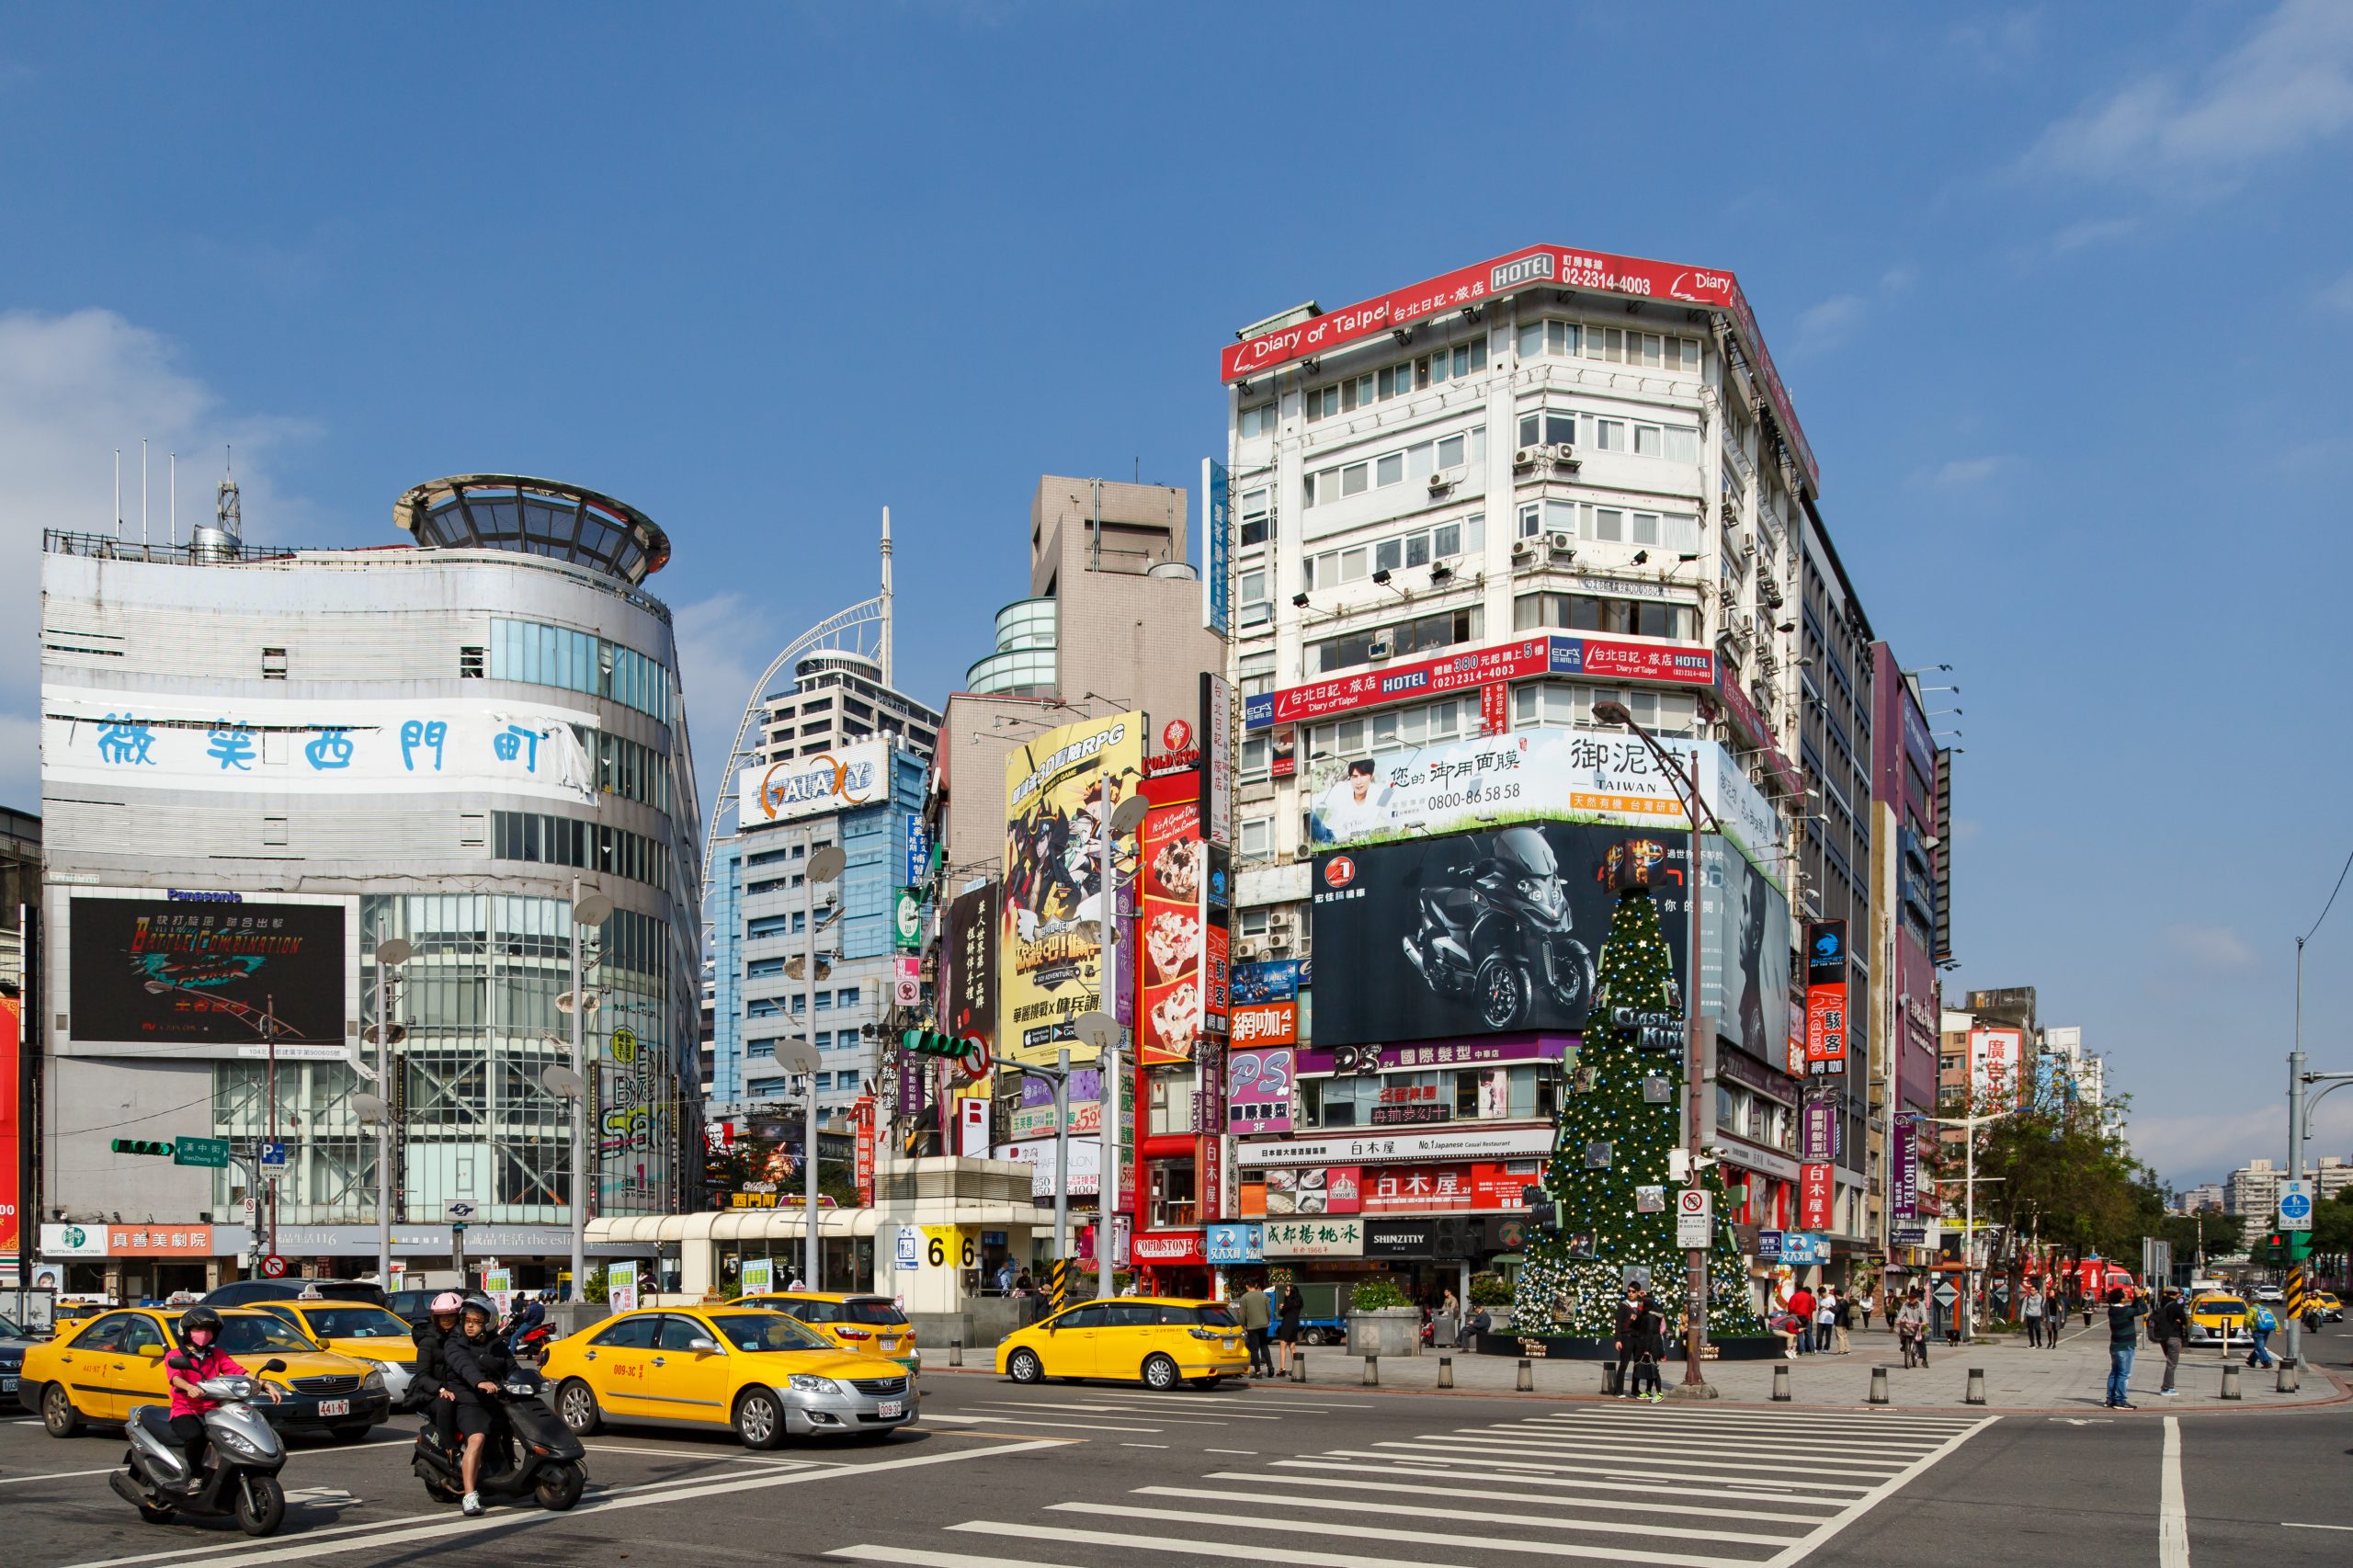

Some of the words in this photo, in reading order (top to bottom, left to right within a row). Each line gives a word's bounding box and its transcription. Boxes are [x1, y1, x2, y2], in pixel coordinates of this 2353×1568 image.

[1563, 255, 1603, 270] 訂房專線
[1495, 257, 1551, 286] HOTEL
[1562, 267, 1651, 296] 02-2314-4003
[1695, 272, 1731, 294] Diary
[1254, 330, 1302, 358] Diary
[1308, 323, 1327, 344] of
[1333, 301, 1390, 330] Taipei
[1675, 655, 1708, 668] HOTEL
[1383, 673, 1426, 692] HOTEL
[1432, 664, 1515, 688] (02)2314-4003
[1309, 701, 1328, 712] Diary
[1329, 699, 1336, 708] of
[1338, 695, 1358, 707] Taipei
[97, 713, 547, 774] 微笑西門町
[1142, 755, 1174, 776] COLD
[1174, 750, 1200, 767] STO
[1571, 739, 1686, 777] 御泥坊
[1597, 779, 1656, 793] TAIWAN
[1574, 795, 1621, 810] 天然有機
[167, 889, 243, 903] Panasonic
[1233, 1008, 1280, 1041] 網咖
[248, 1047, 341, 1058] 104北都建廣字第900605號
[1400, 1045, 1472, 1064] 國際髮型
[1333, 1044, 1382, 1080] PS
[1811, 1060, 1842, 1074] 網咖
[1230, 1051, 1290, 1096] PS
[1380, 1085, 1437, 1102] 名留集團
[1254, 1122, 1265, 1131] 3F
[184, 1142, 221, 1154] 漢中街
[263, 1144, 273, 1158] P
[1351, 1141, 1396, 1155] 白木屋
[1435, 1142, 1463, 1150] Japanese
[1207, 1142, 1218, 1203] 白木屋
[1378, 1171, 1460, 1197] 白木屋
[1809, 1165, 1825, 1212] 白木屋
[1904, 1165, 1915, 1208] HOTEL
[733, 1193, 777, 1207] 西門町
[112, 1233, 207, 1247] 真善美劇院
[528, 1233, 547, 1244] the
[551, 1233, 572, 1244] esli
[1267, 1224, 1361, 1245] 成都楊桃冰
[928, 1237, 944, 1267] 6
[961, 1237, 974, 1267] 6
[1134, 1240, 1162, 1255] COLD
[1162, 1238, 1193, 1254] STONE
[614, 1364, 636, 1377] 009-3C
[320, 1402, 348, 1415] 441-N7
[880, 1403, 901, 1416] 009-3C
